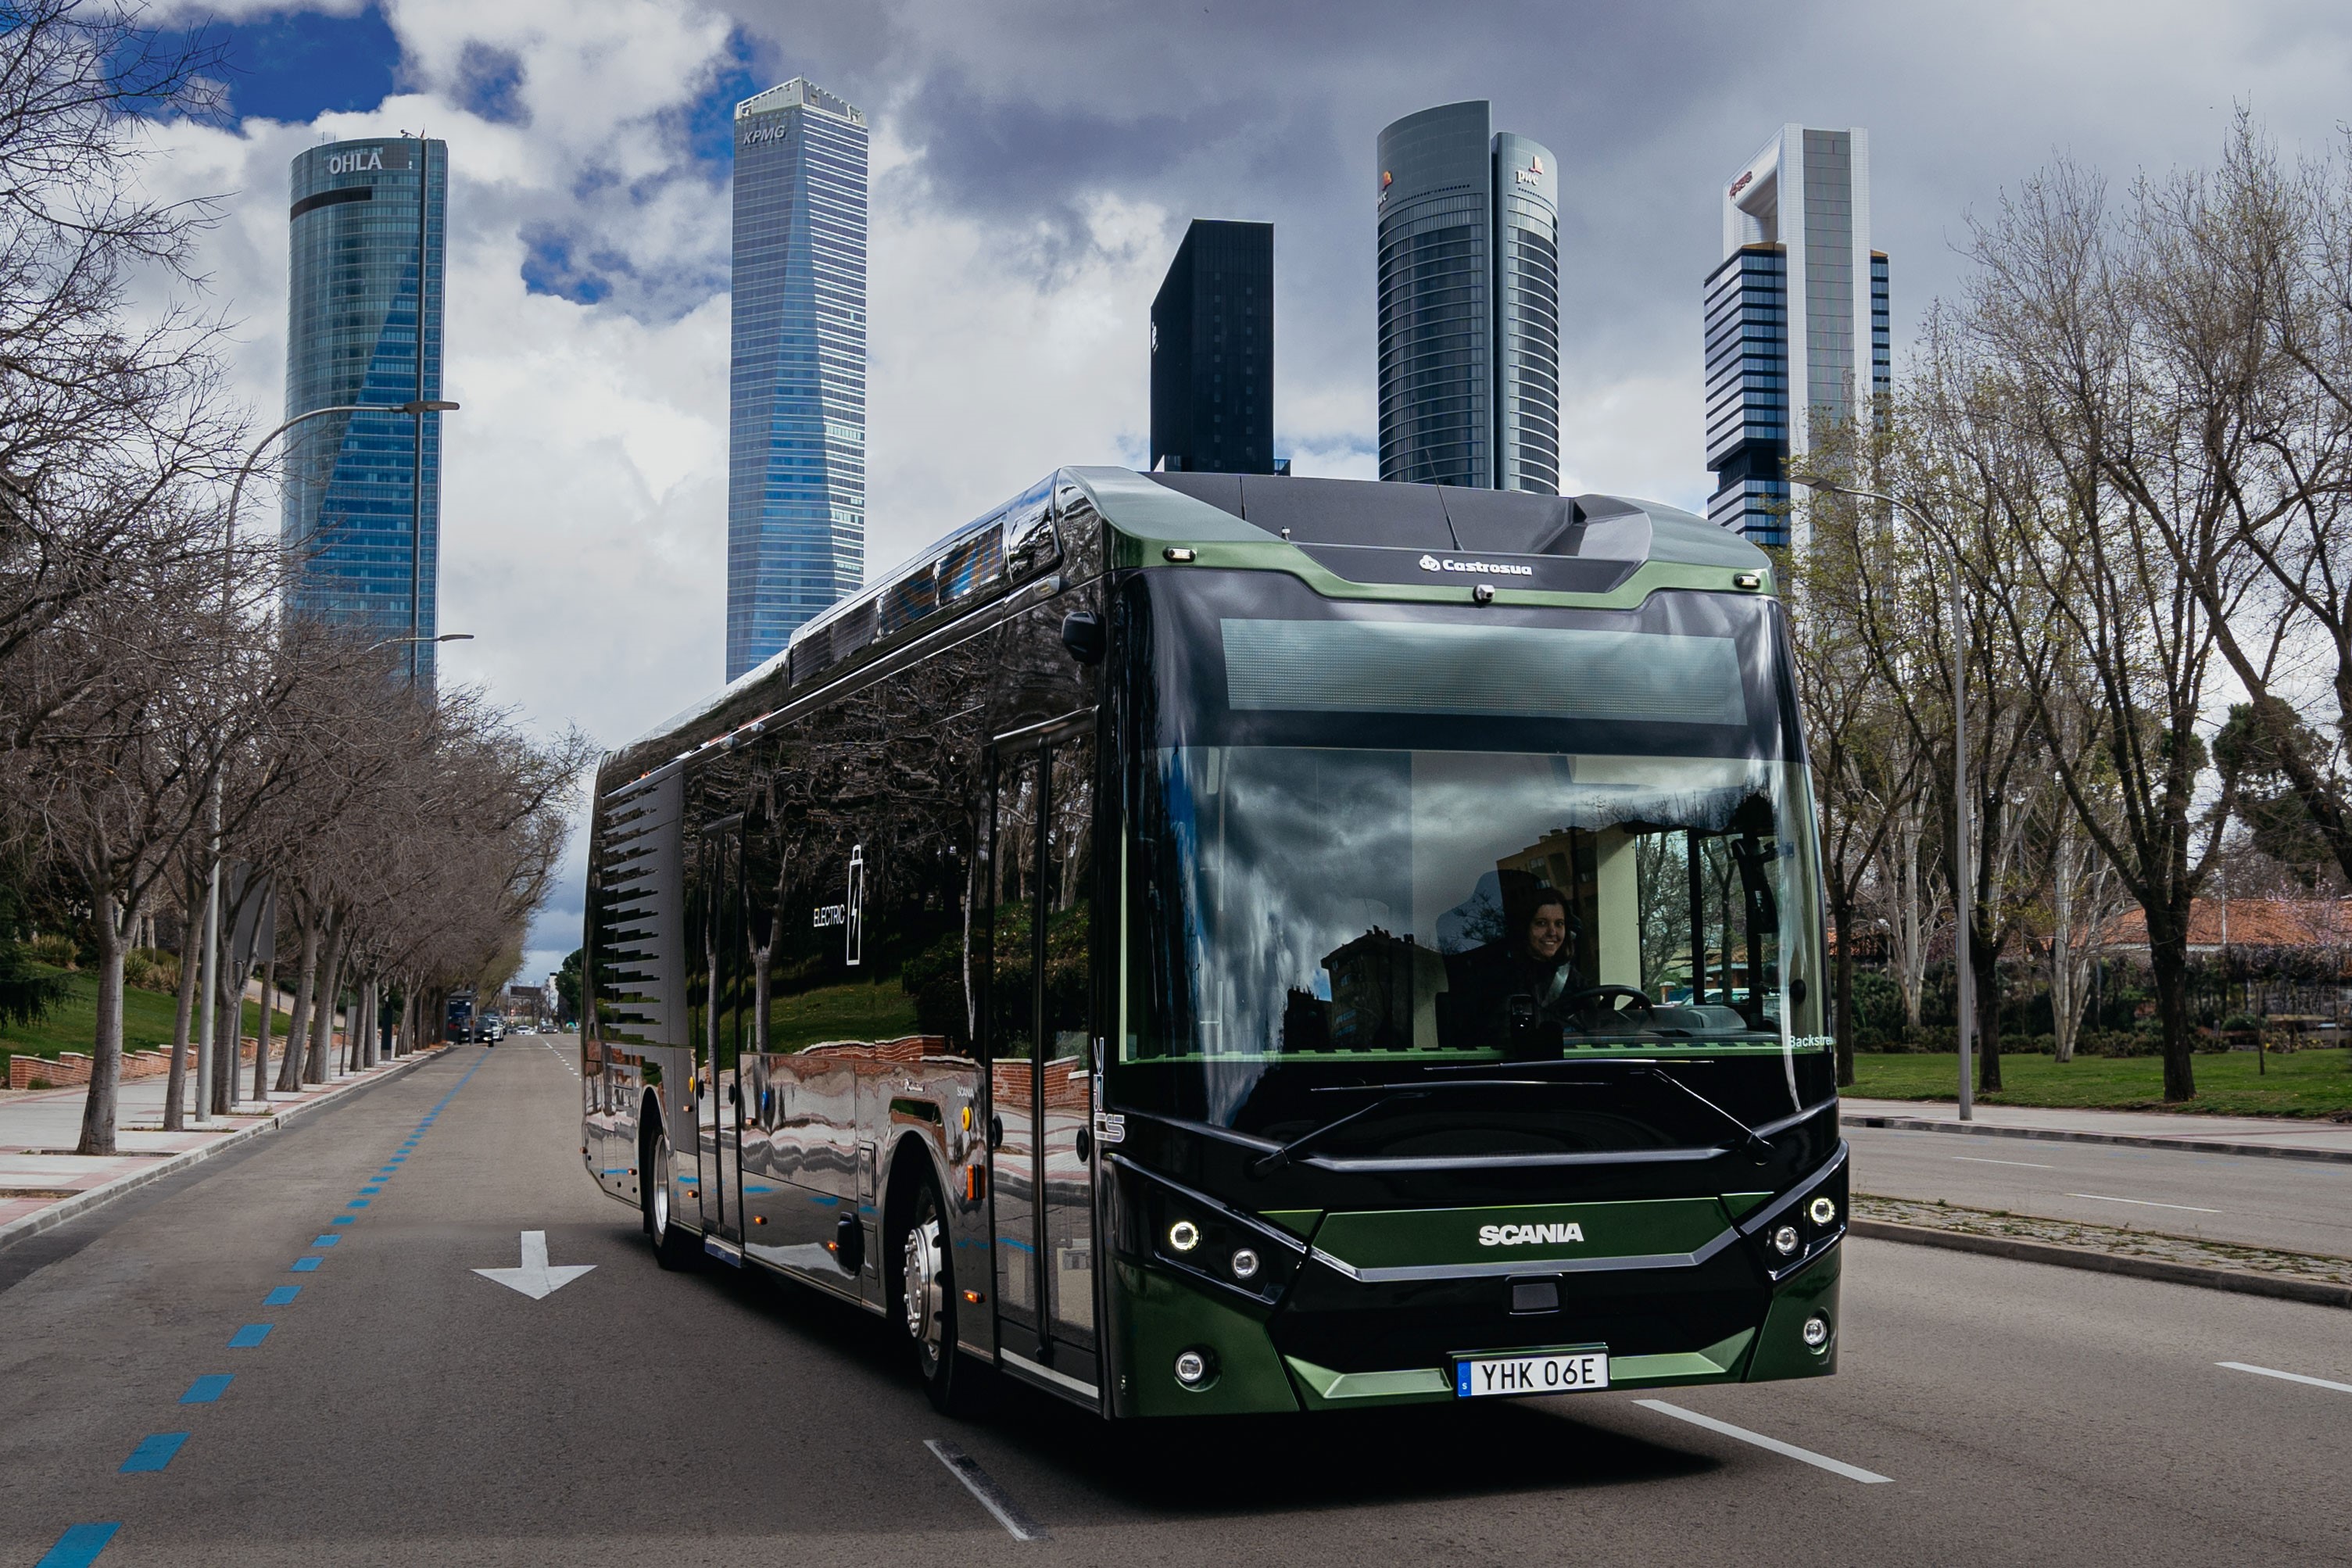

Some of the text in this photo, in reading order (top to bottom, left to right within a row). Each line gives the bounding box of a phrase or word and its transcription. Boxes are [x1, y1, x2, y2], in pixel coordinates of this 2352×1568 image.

[743, 125, 786, 145] KPMG
[329, 152, 382, 174] OHLA
[1442, 559, 1533, 576] Castrosua
[814, 904, 845, 928] ELECTRIC
[1478, 1223, 1584, 1246] SCANIA
[1481, 1362, 1534, 1391] YHK
[1544, 1358, 1596, 1387] 06E
